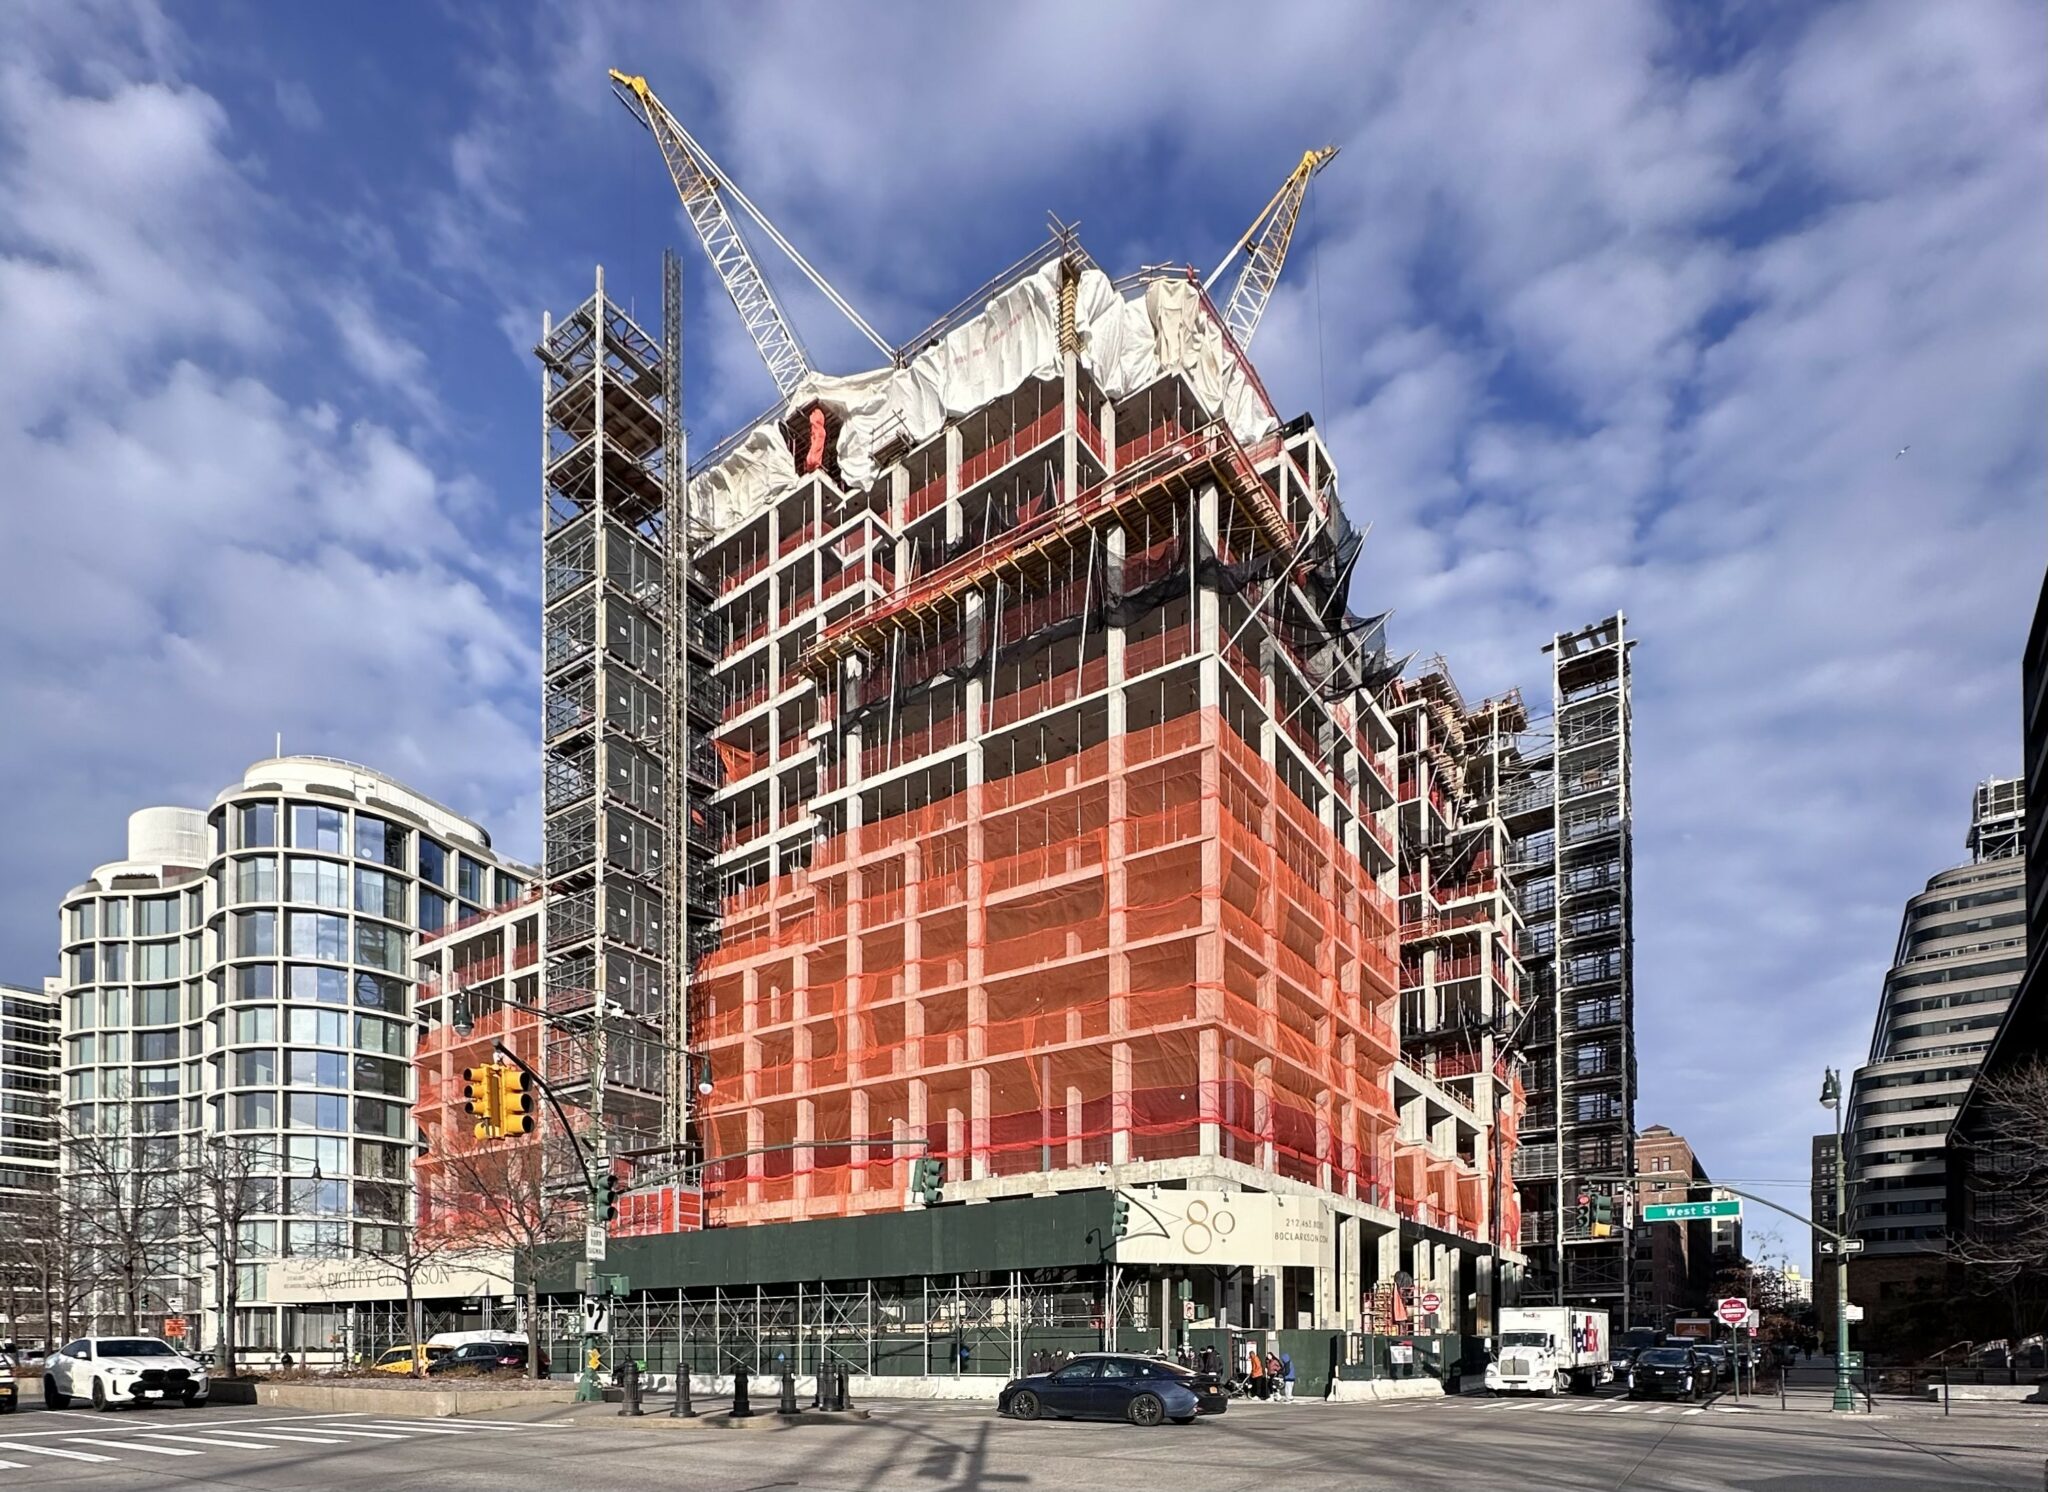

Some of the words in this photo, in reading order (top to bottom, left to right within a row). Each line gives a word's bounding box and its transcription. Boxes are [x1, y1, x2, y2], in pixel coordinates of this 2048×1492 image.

[1666, 1206, 1696, 1217] West
[1702, 1204, 1717, 1215] St
[1182, 1200, 1236, 1255] 80
[327, 1270, 373, 1289] EIGHTY
[377, 1265, 450, 1287] CLAKSON
